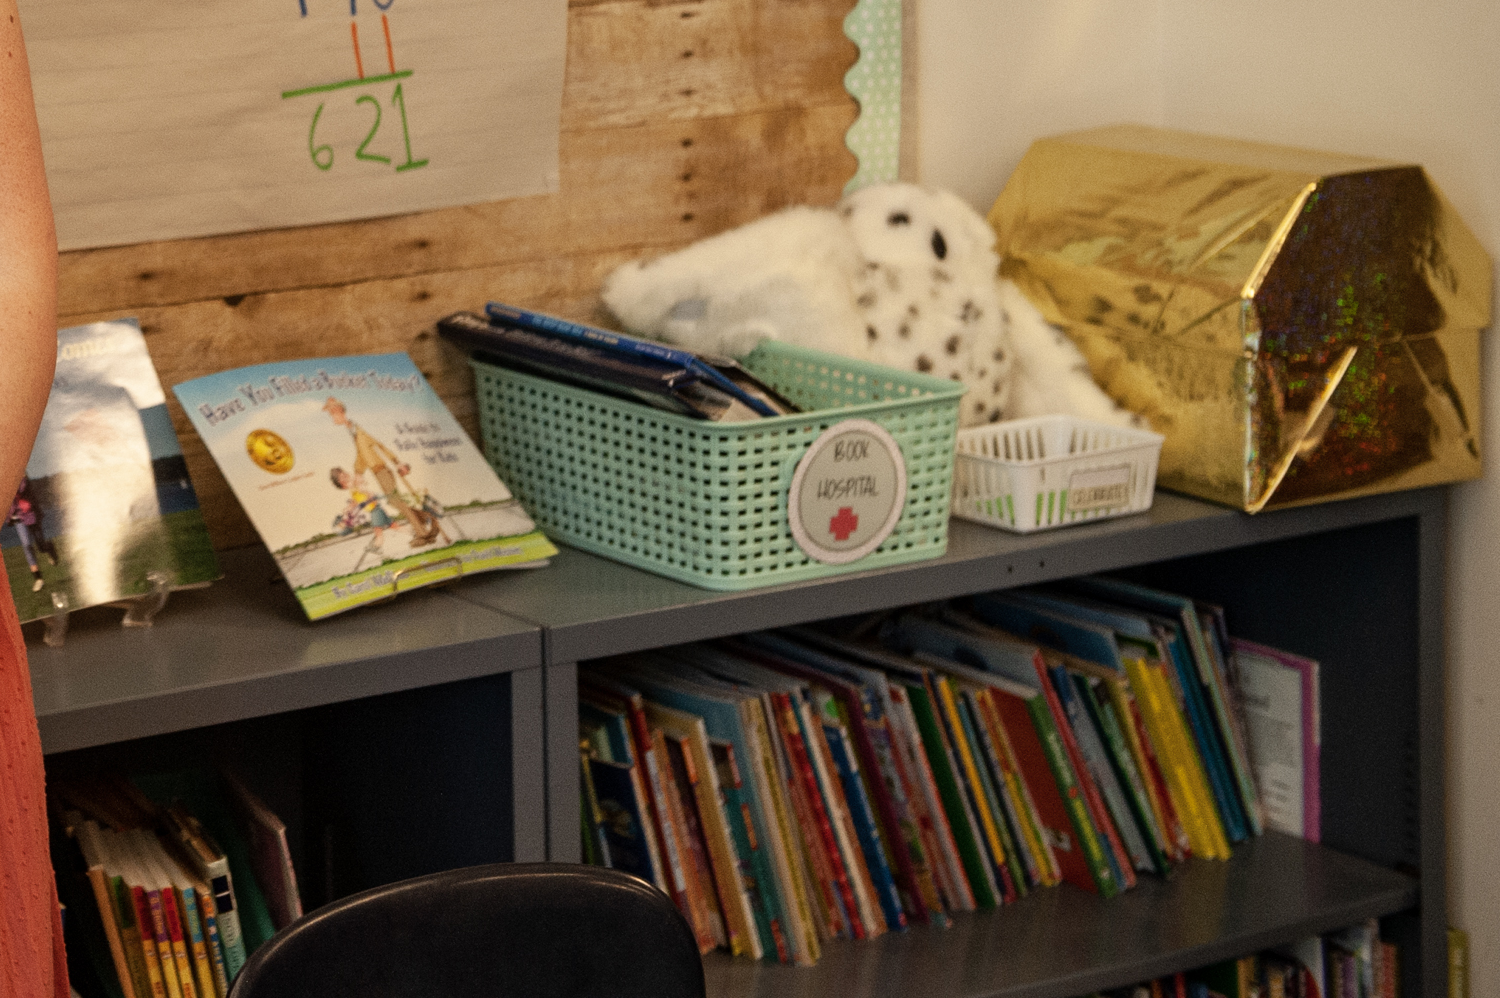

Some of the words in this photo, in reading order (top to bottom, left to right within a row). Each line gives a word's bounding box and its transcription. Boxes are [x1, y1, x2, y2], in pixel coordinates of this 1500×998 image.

[309, 82, 429, 171] 621
[834, 440, 870, 463] BOOK
[817, 475, 880, 500] HOSPITAL
